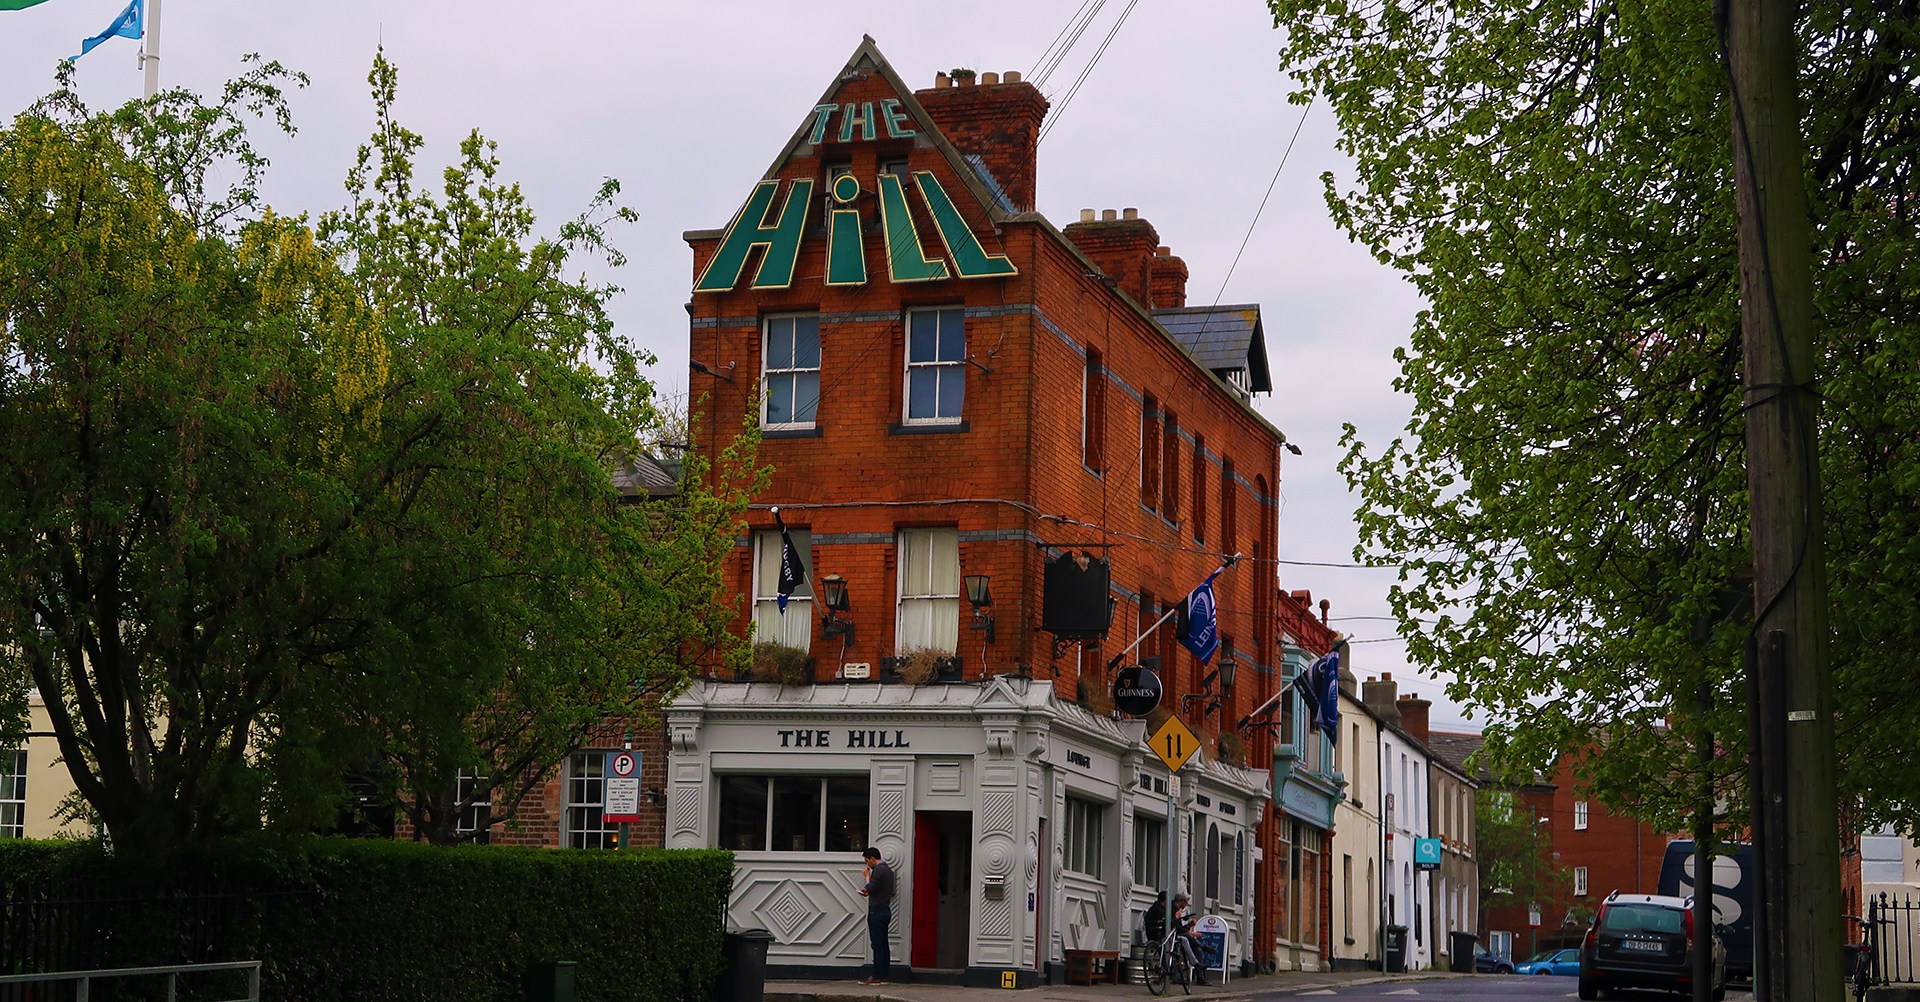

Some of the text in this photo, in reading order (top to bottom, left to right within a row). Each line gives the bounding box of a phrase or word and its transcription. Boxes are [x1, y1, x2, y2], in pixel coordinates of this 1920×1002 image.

[808, 98, 917, 145] THE
[1117, 687, 1155, 698] GUINNESS
[777, 729, 911, 749] THE HILL
[1003, 973, 1015, 987] H
